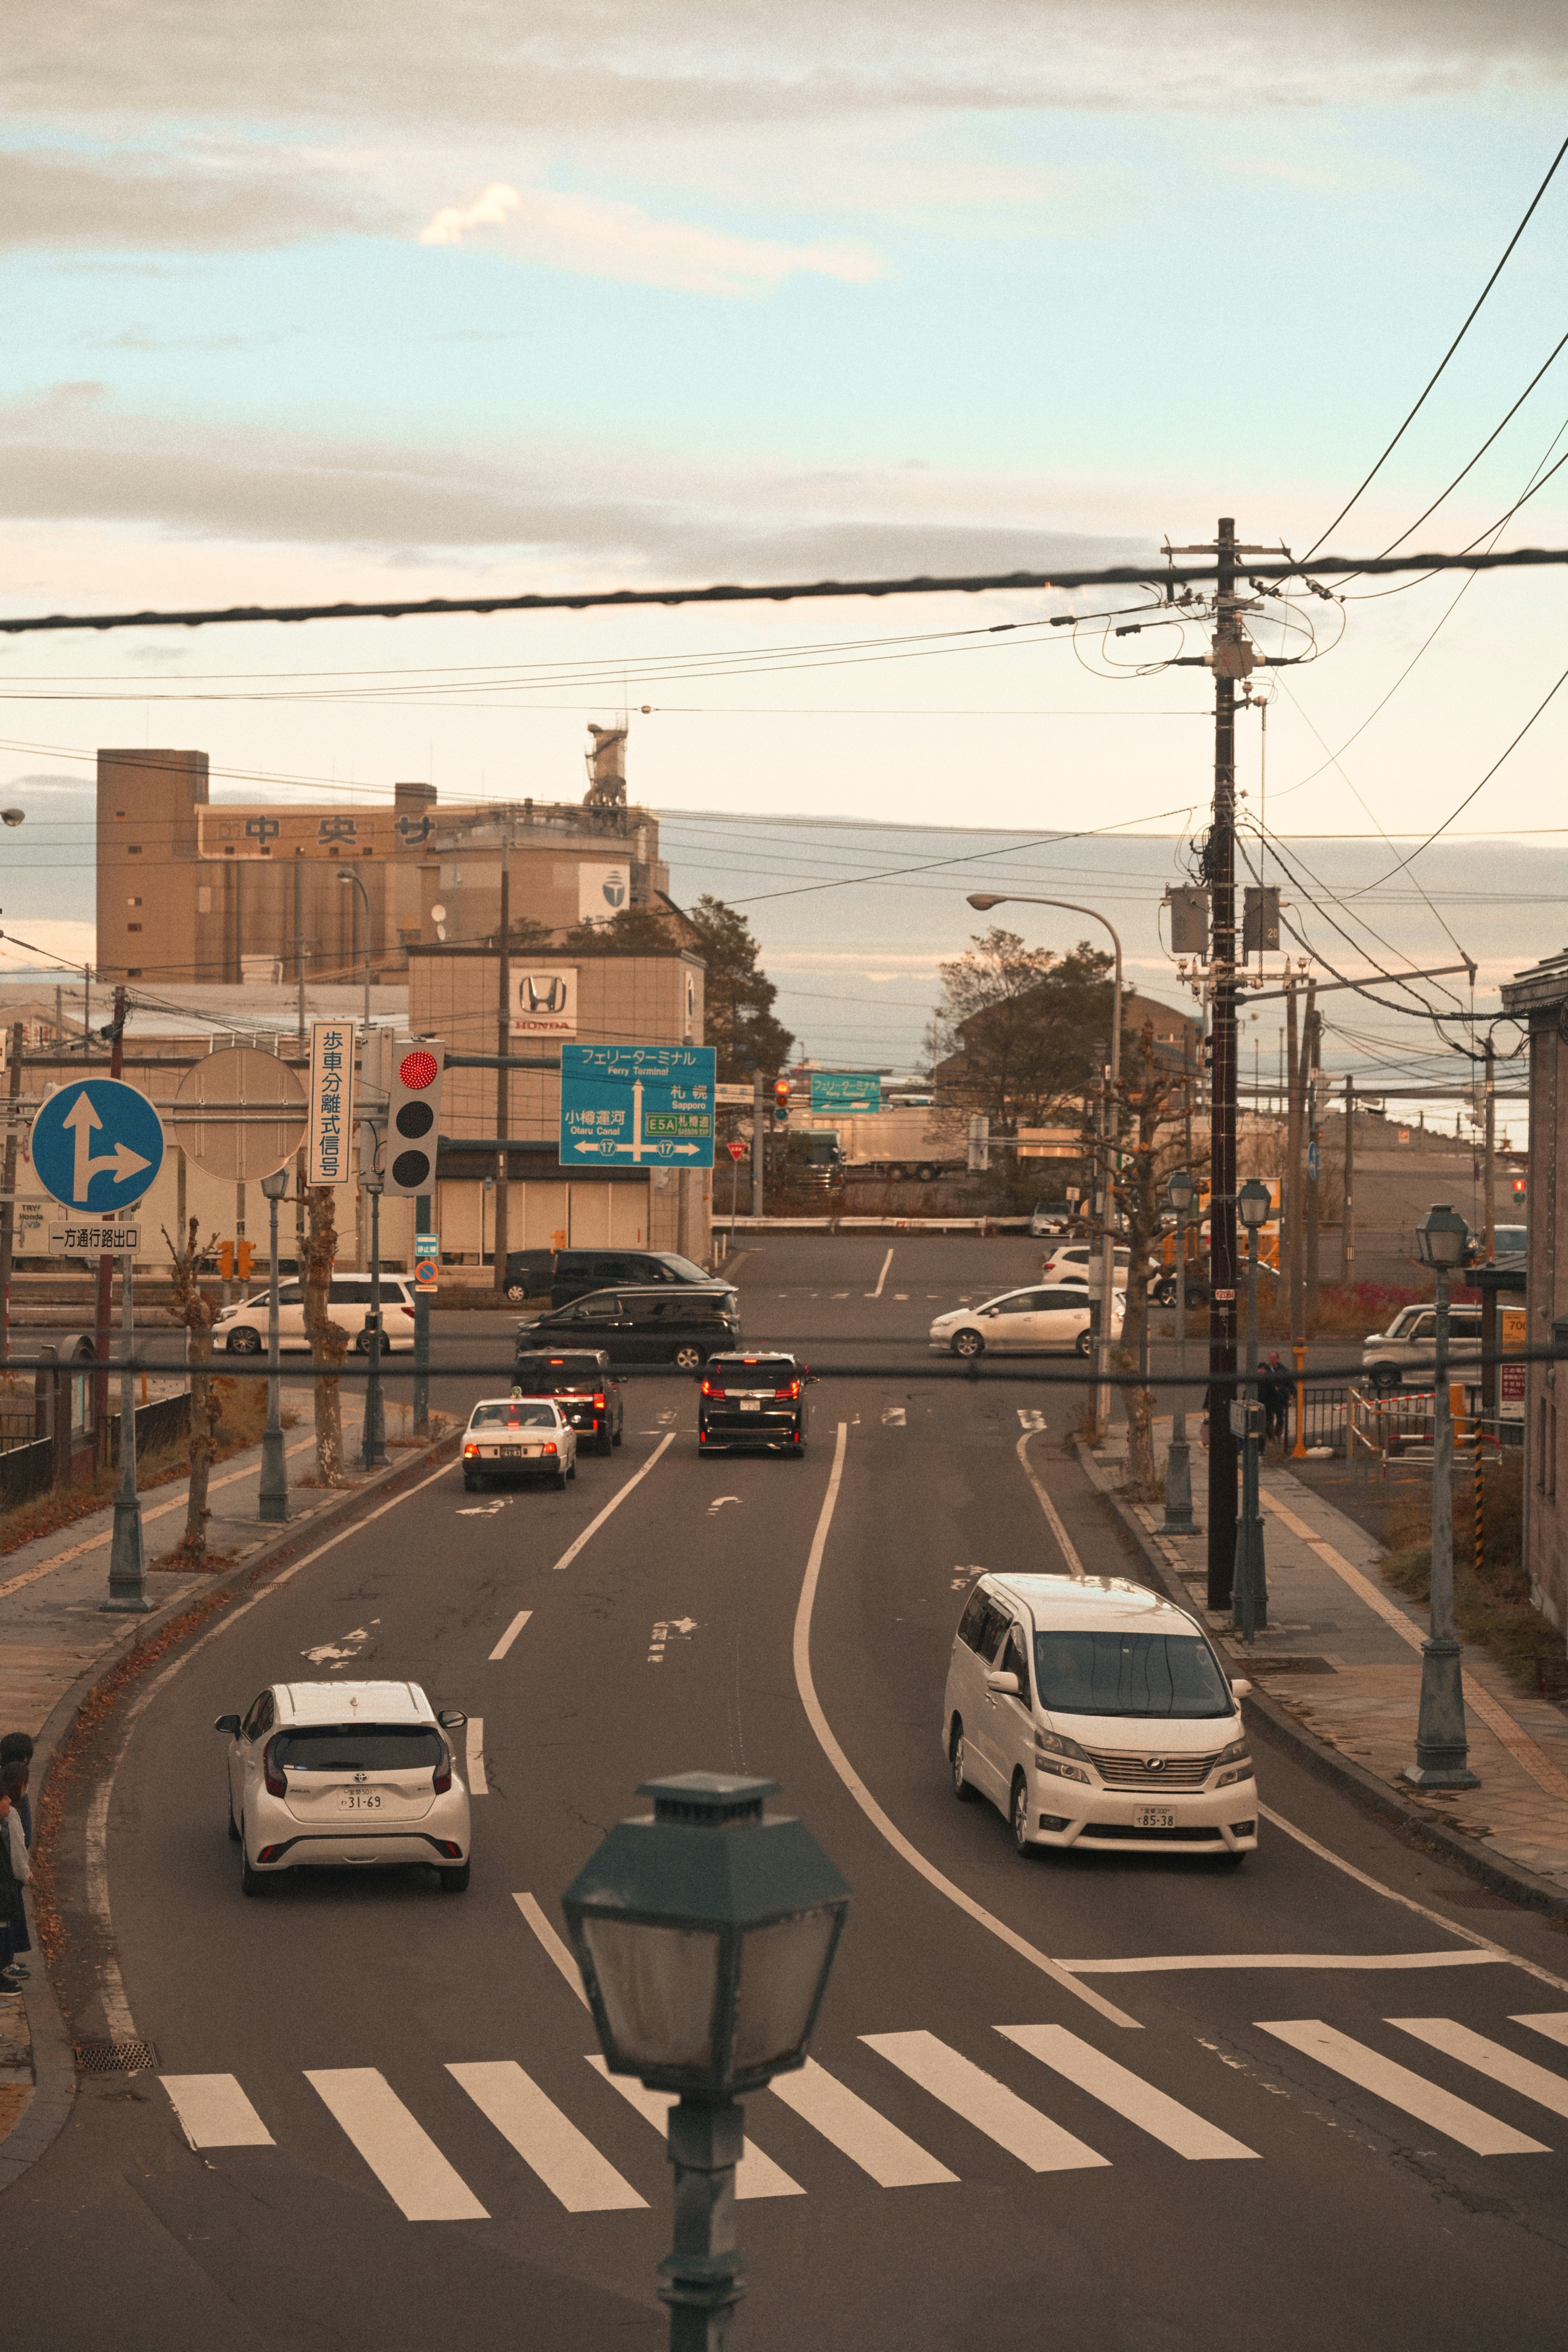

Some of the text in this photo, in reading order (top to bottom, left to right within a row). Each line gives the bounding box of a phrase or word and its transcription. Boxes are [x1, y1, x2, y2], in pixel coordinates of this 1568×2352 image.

[1267, 928, 1278, 939] 20
[515, 1021, 569, 1030] HONDA
[582, 1049, 696, 1066] フェリーターミナル
[608, 1066, 668, 1076] Ferry Terminal
[814, 1080, 878, 1090] フェリーターミナル
[670, 1084, 708, 1100] 札幌
[319, 1031, 343, 1176] 歩車分離式信号
[672, 1101, 706, 1110] Sapporo
[565, 1110, 626, 1125] 小樽運河
[649, 1118, 674, 1130] E5A
[570, 1126, 620, 1135] Otaru Canal
[602, 1142, 613, 1153] 17
[660, 1143, 672, 1154] 17
[52, 1228, 137, 1248] 一方通行路出口
[348, 1796, 381, 1808] 31-69
[1143, 1815, 1174, 1826] 85-38
